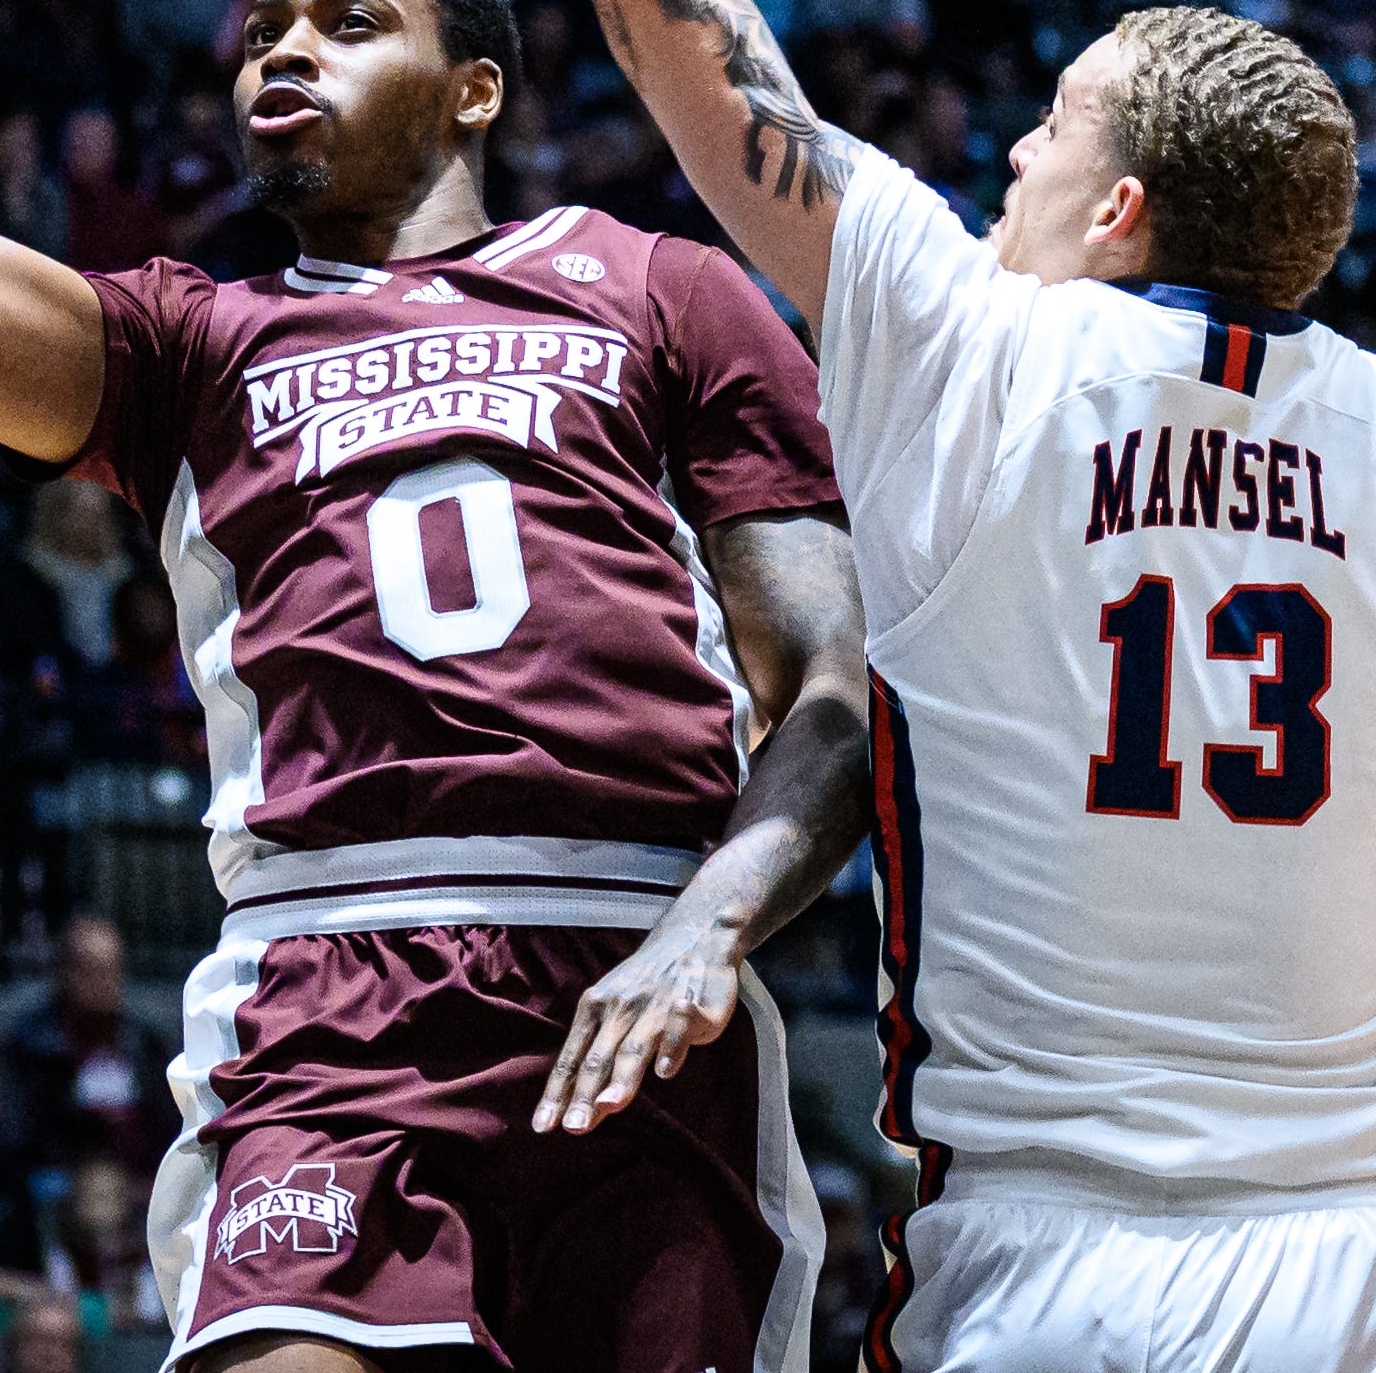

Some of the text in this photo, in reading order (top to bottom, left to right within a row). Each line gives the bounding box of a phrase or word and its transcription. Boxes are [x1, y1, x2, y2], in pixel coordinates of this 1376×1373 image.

[555, 256, 602, 281] SEC
[246, 331, 628, 431] MISSISSIPPI
[338, 390, 508, 449] STATE
[1085, 426, 1346, 561] MANSEL
[366, 456, 531, 662] 0
[1085, 573, 1333, 826] 13
[235, 1192, 325, 1230] STATE
